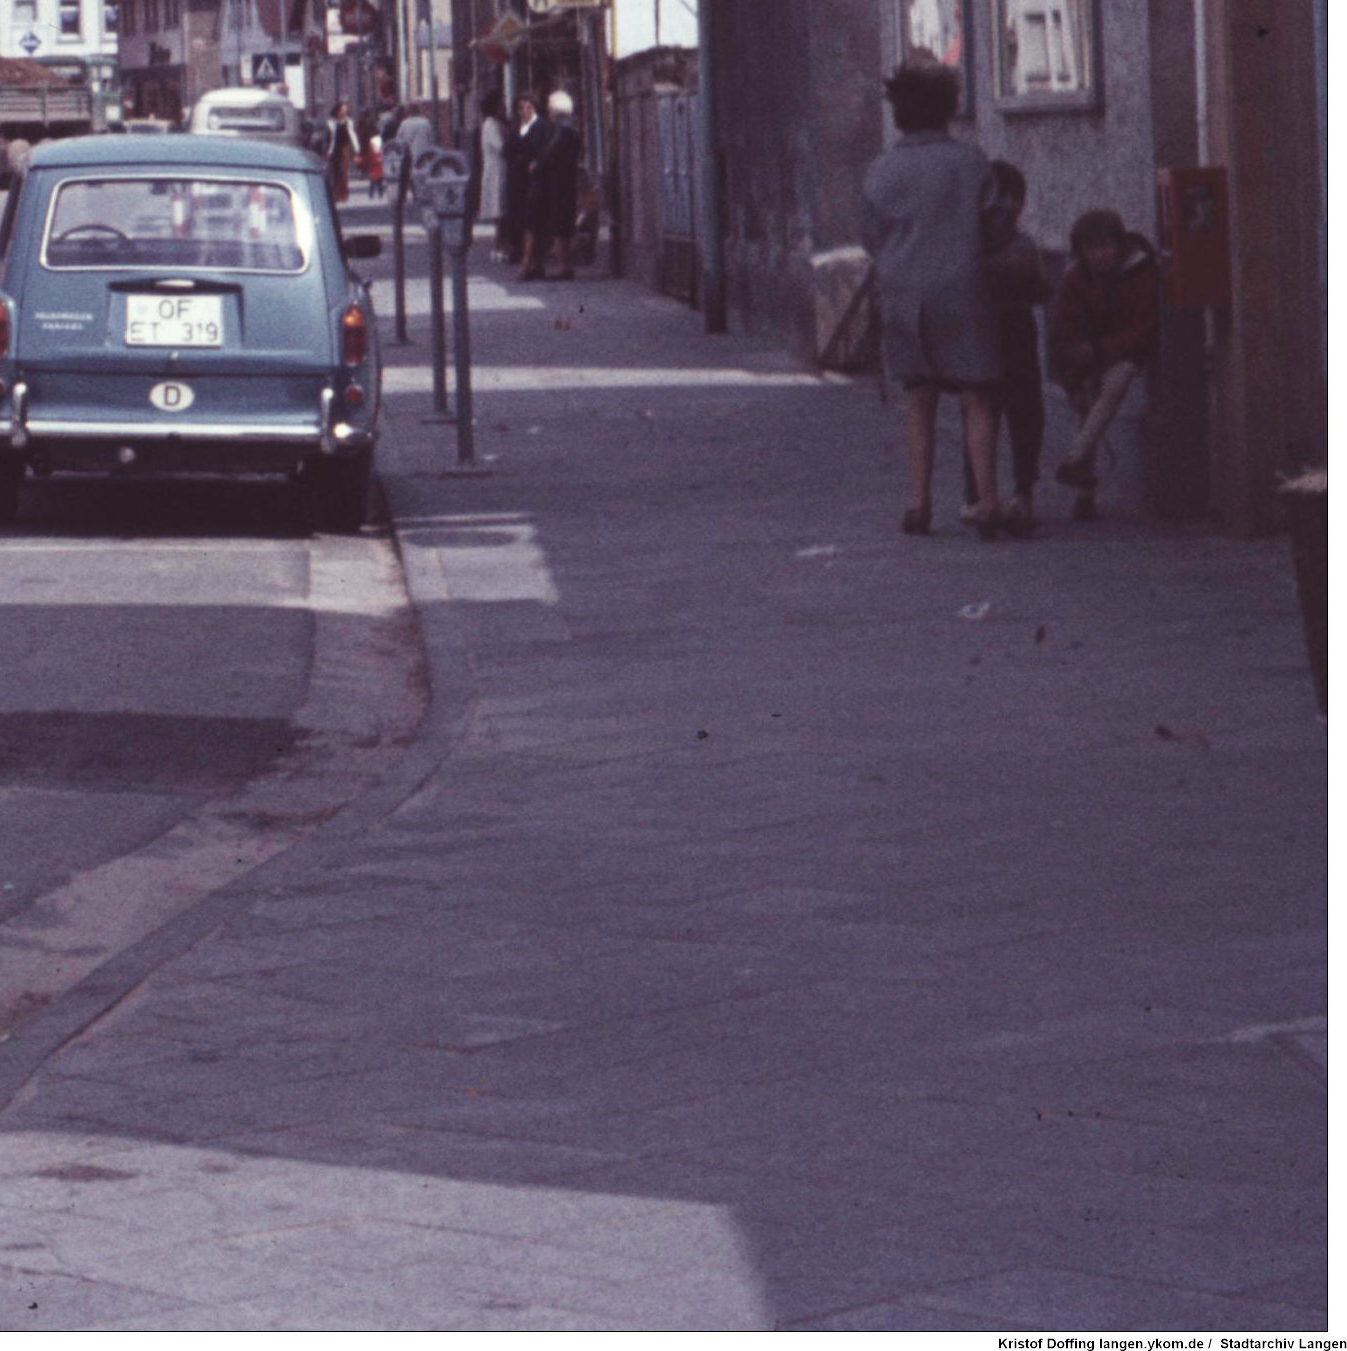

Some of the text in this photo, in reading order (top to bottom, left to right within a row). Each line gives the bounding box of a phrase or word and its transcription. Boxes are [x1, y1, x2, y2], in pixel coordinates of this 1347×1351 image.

[159, 299, 193, 320] OF
[130, 321, 219, 342] ET 319
[163, 384, 181, 407] D
